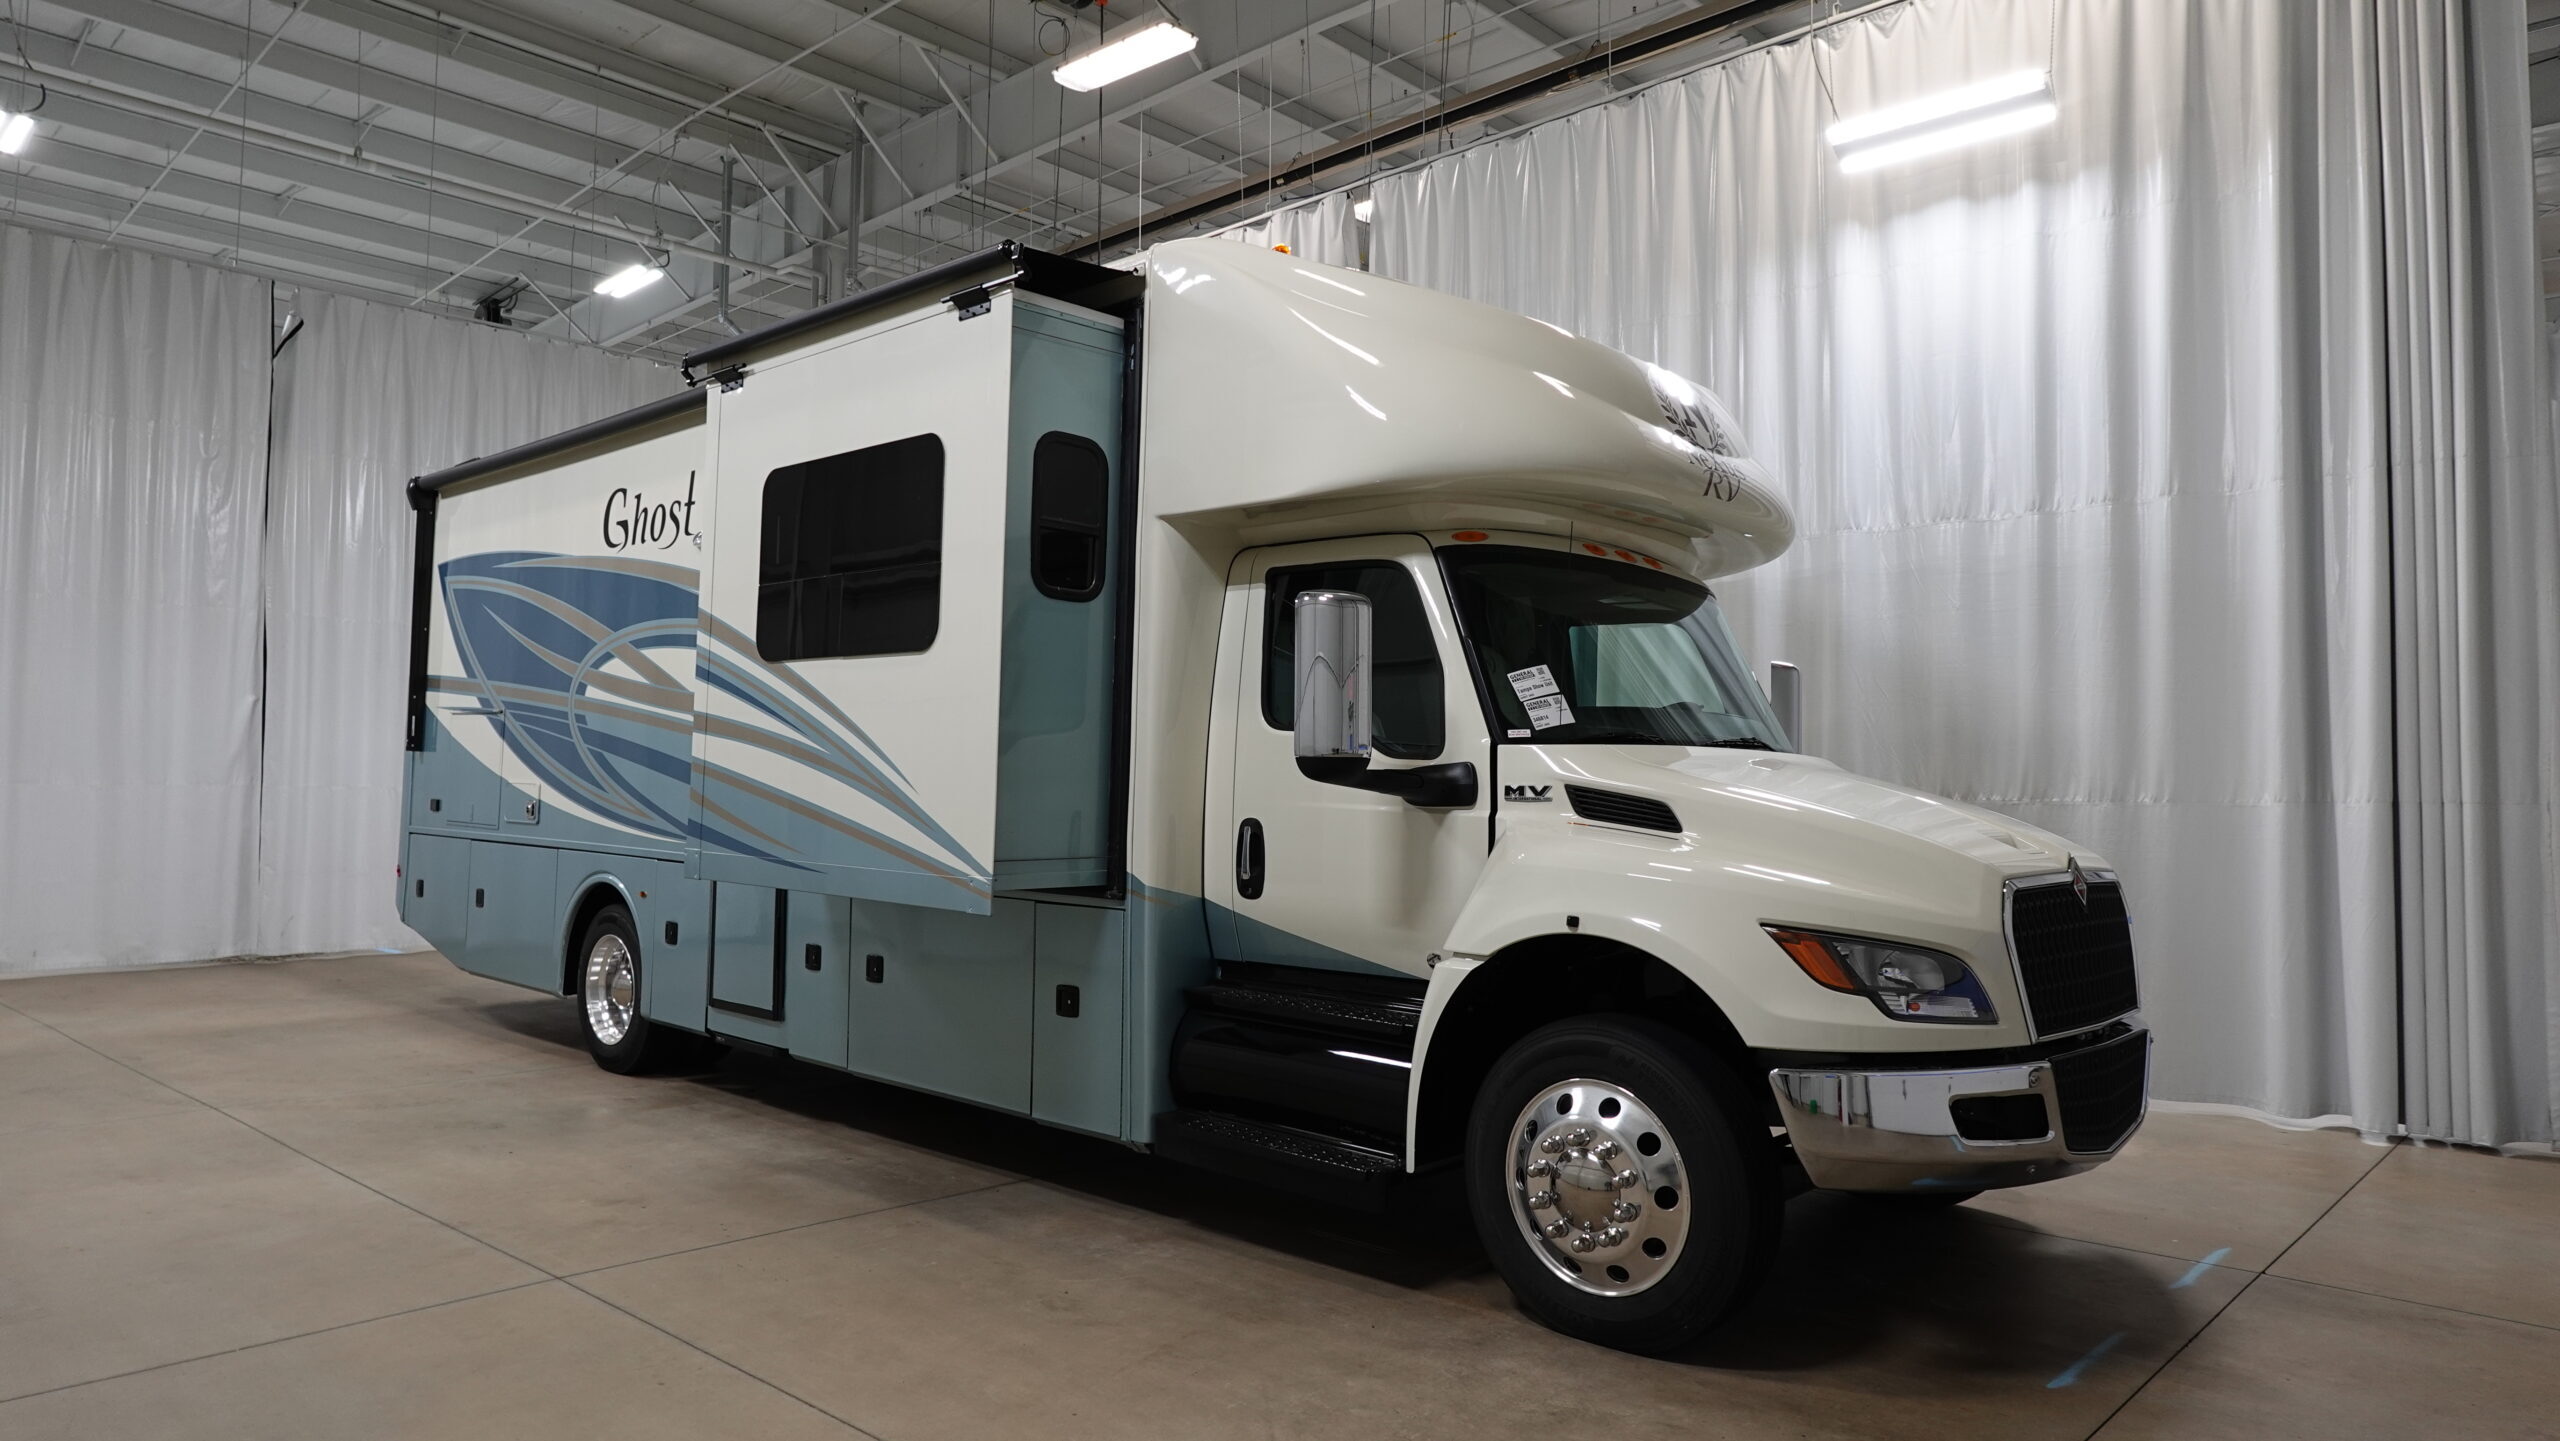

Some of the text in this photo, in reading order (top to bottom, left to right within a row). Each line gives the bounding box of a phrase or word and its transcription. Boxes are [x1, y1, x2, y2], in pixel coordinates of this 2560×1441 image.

[1703, 469, 1741, 502] RV
[603, 470, 696, 554] Ghost
[1510, 670, 1534, 679] GENERAL
[1526, 699, 1550, 707] GENERAL
[1504, 785, 1552, 797] MV
